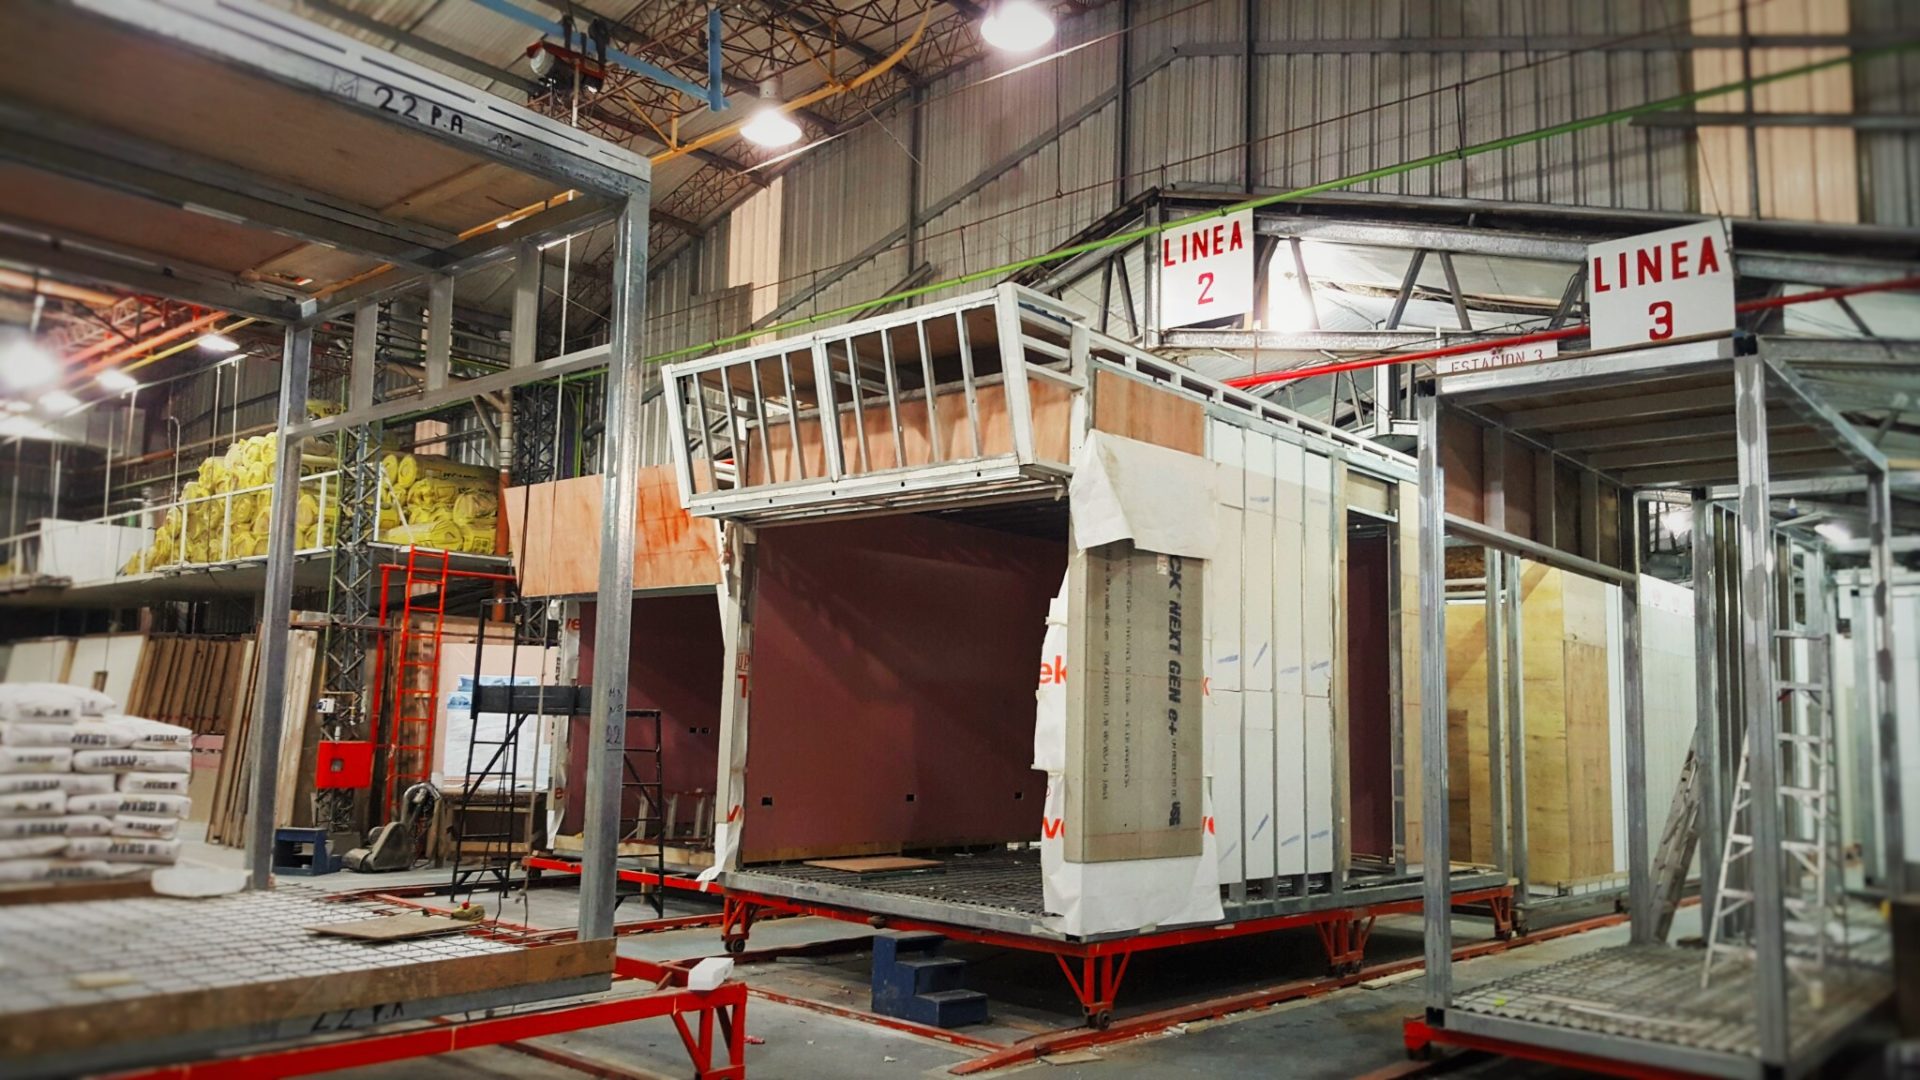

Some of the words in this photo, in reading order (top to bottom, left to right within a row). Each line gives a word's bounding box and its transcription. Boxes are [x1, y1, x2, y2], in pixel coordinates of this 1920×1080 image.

[374, 86, 419, 121] 22
[431, 105, 463, 134] P.A
[1163, 220, 1243, 268] LINEA
[1594, 236, 1720, 293] LINEA
[1197, 272, 1214, 305] 2
[1648, 300, 1673, 342] 3
[1168, 600, 1182, 655] NEXT
[1168, 660, 1181, 704] GEN
[1168, 708, 1178, 736] e+
